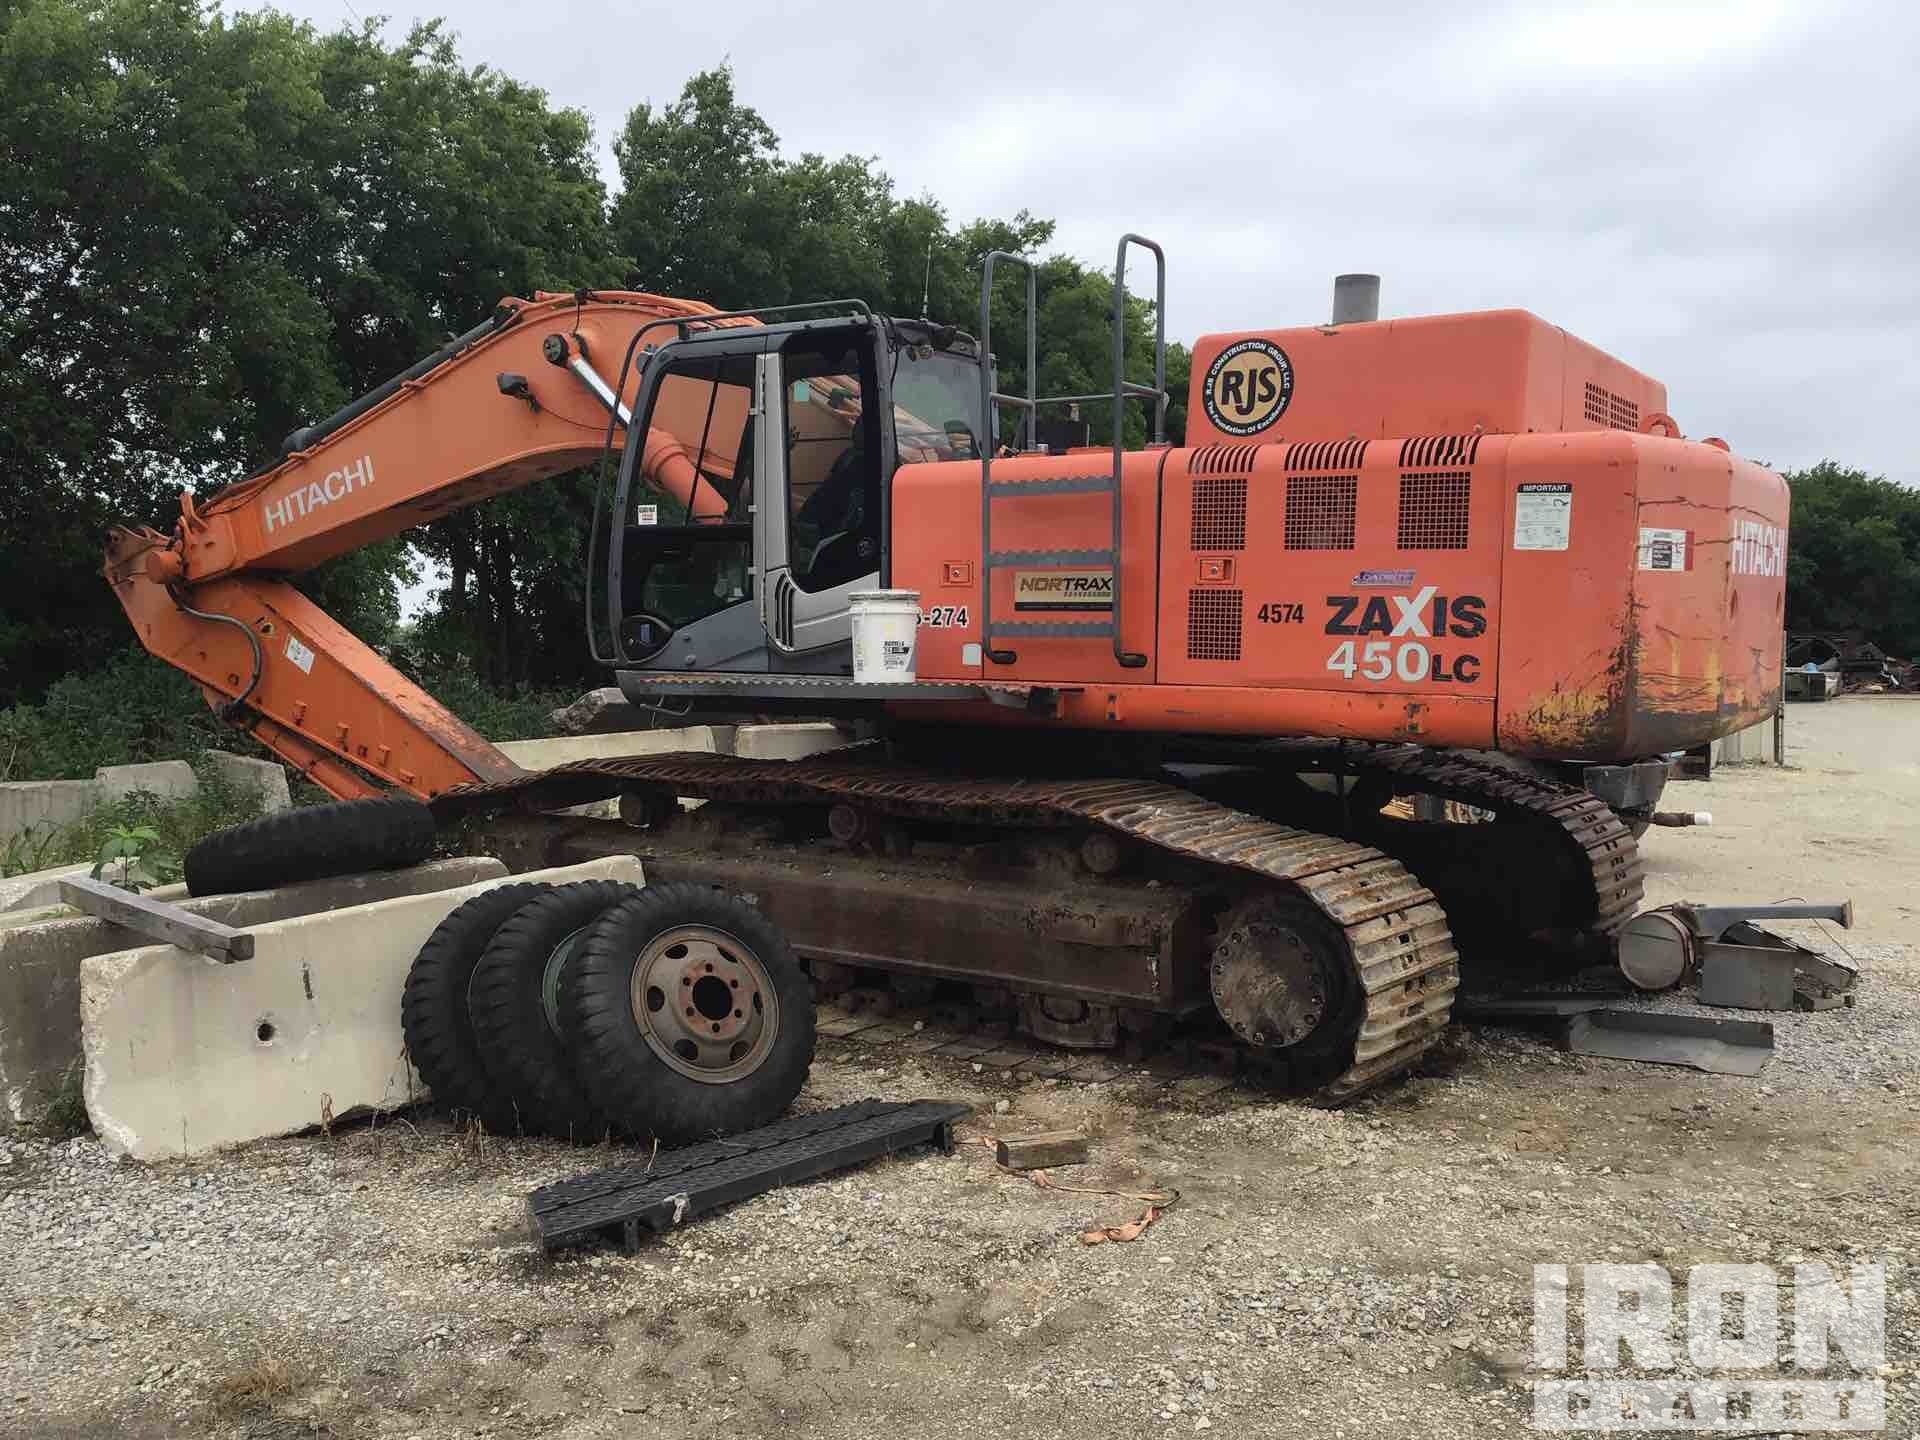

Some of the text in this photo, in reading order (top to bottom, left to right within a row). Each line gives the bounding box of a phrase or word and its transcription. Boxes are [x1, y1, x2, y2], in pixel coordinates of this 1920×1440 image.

[1211, 342, 1267, 375] CONSTRUCTION
[1267, 347, 1288, 372] GROUP
[1221, 366, 1277, 416] RJS
[264, 455, 375, 533] HITACHI
[1522, 484, 1568, 492] IMPORTANT
[1732, 519, 1788, 577] HITACHI
[1019, 576, 1113, 592] NORTRAX
[1257, 602, 1305, 624] 4574
[1324, 586, 1488, 639] ZAXIS
